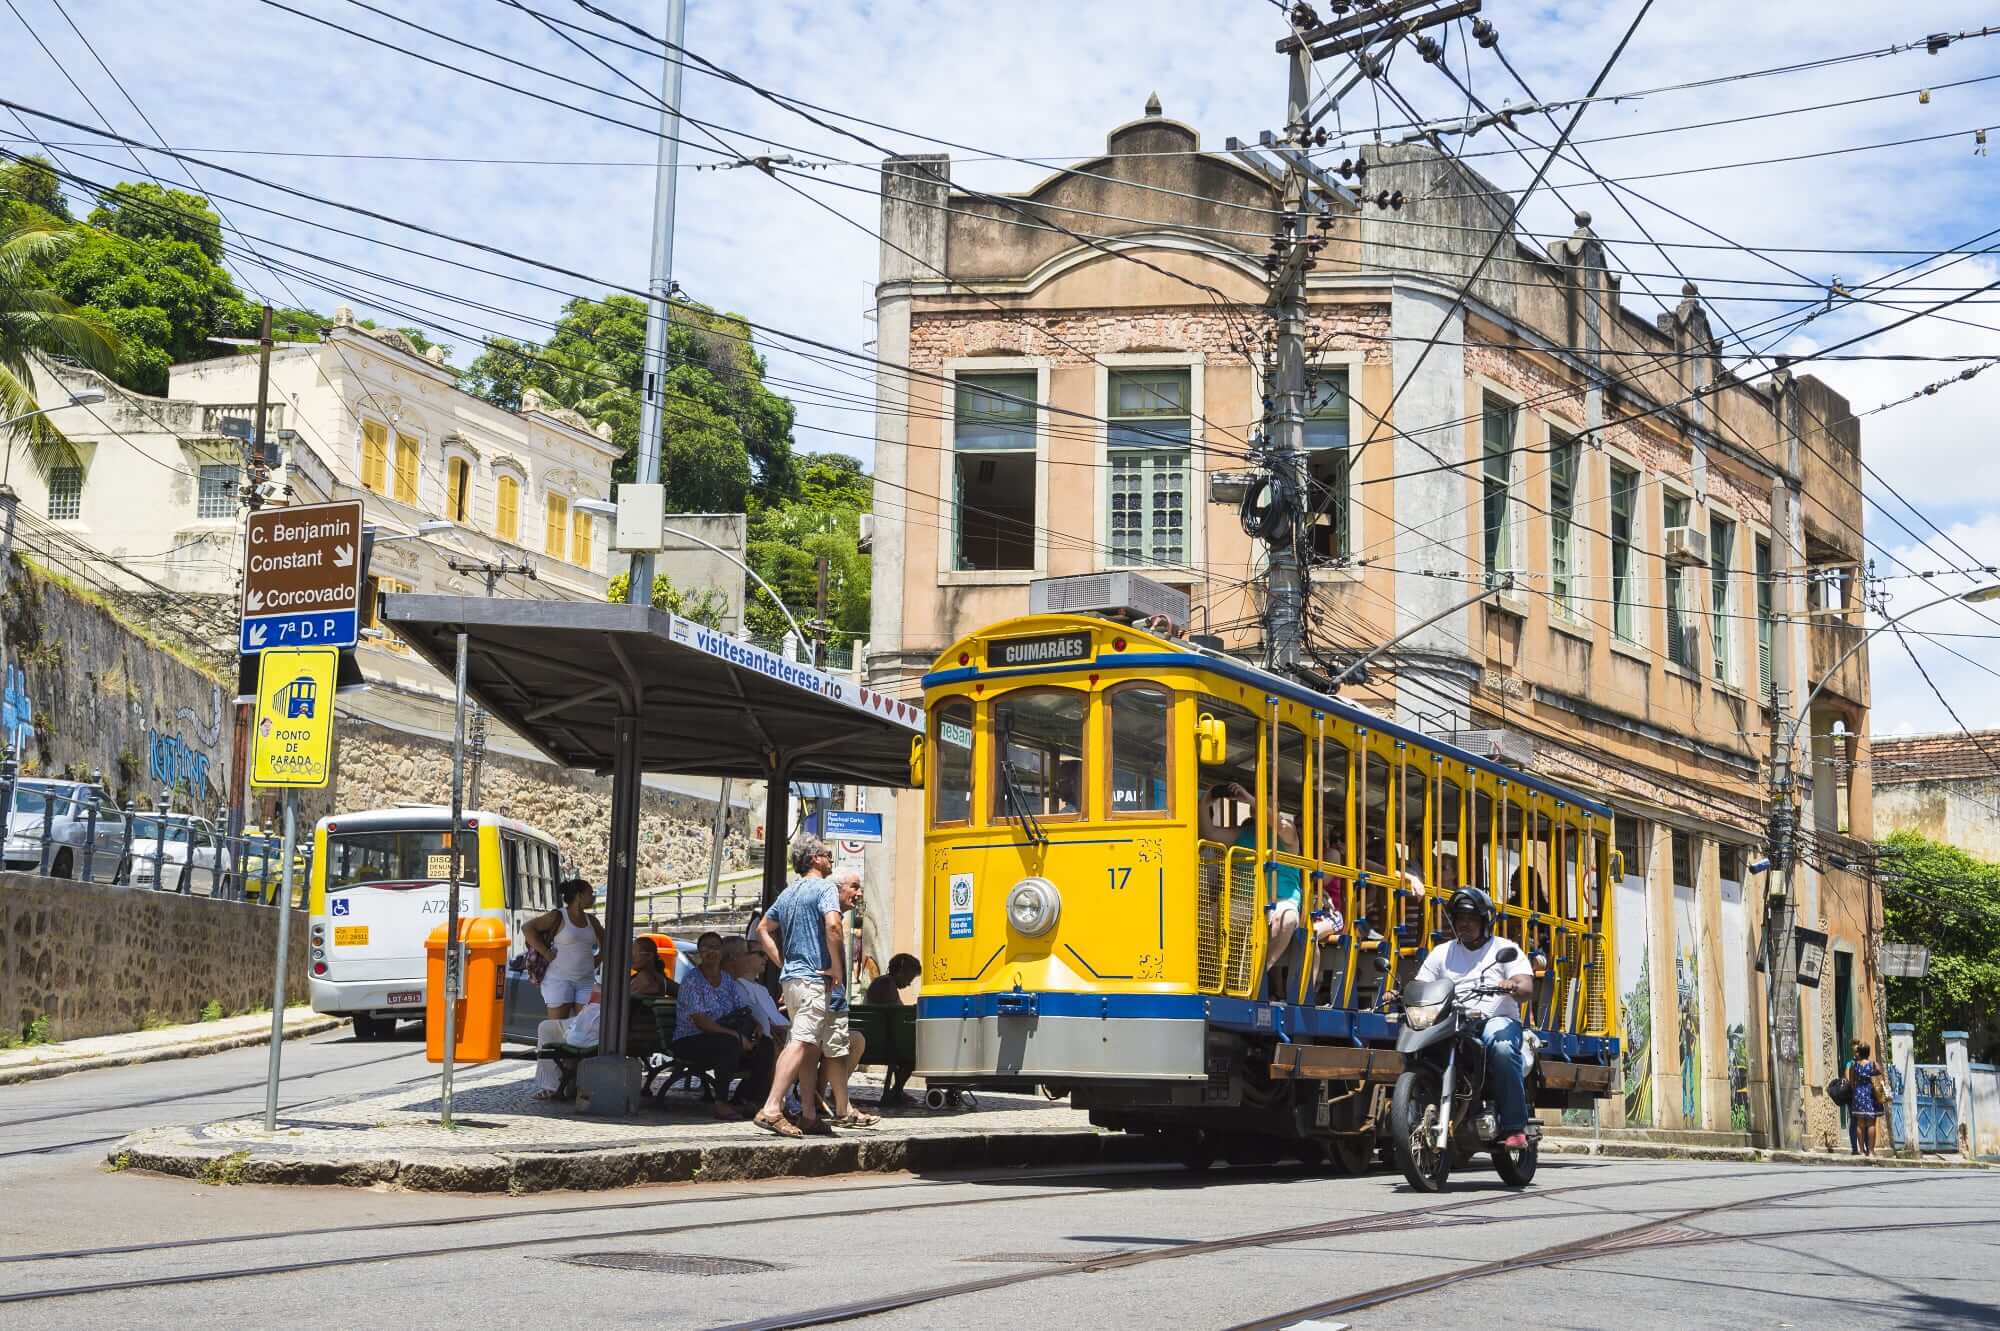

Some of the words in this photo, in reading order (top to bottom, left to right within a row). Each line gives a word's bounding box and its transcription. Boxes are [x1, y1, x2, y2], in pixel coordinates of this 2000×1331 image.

[251, 526, 268, 544] C.
[274, 518, 350, 544] Benjamin
[250, 549, 323, 573] Constant
[266, 584, 355, 607] Corcovado
[278, 621, 296, 641] 7ª
[301, 621, 318, 639] D.
[323, 619, 336, 637] P.
[1006, 638, 1083, 663] GUIMARÃES
[696, 629, 842, 700] visitesantateresa.rio
[275, 730, 311, 741] PONTO
[285, 742, 298, 753] DE
[270, 754, 312, 766] PARADA
[1107, 867, 1132, 890] 17
